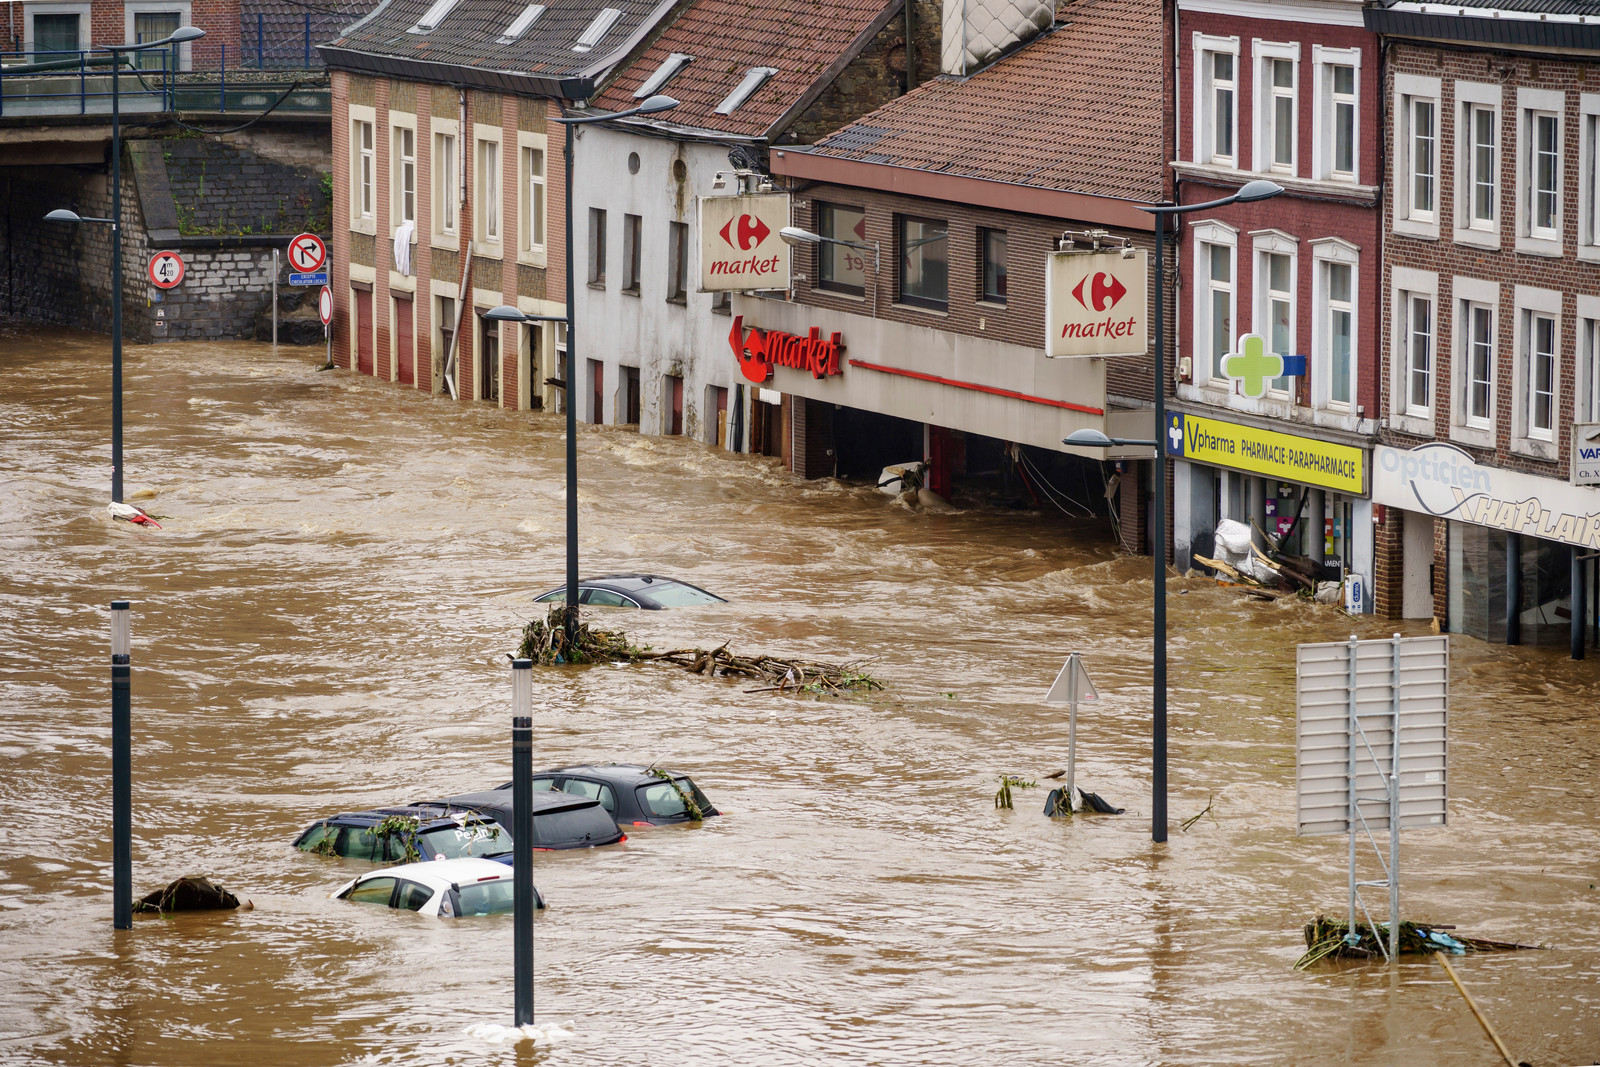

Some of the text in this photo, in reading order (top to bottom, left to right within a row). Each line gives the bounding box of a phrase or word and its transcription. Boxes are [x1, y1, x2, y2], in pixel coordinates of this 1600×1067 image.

[710, 255, 780, 276] market
[1061, 316, 1137, 339] market
[765, 326, 843, 379] market
[1187, 421, 1235, 453] Vpharma
[1381, 448, 1491, 492] Opticien
